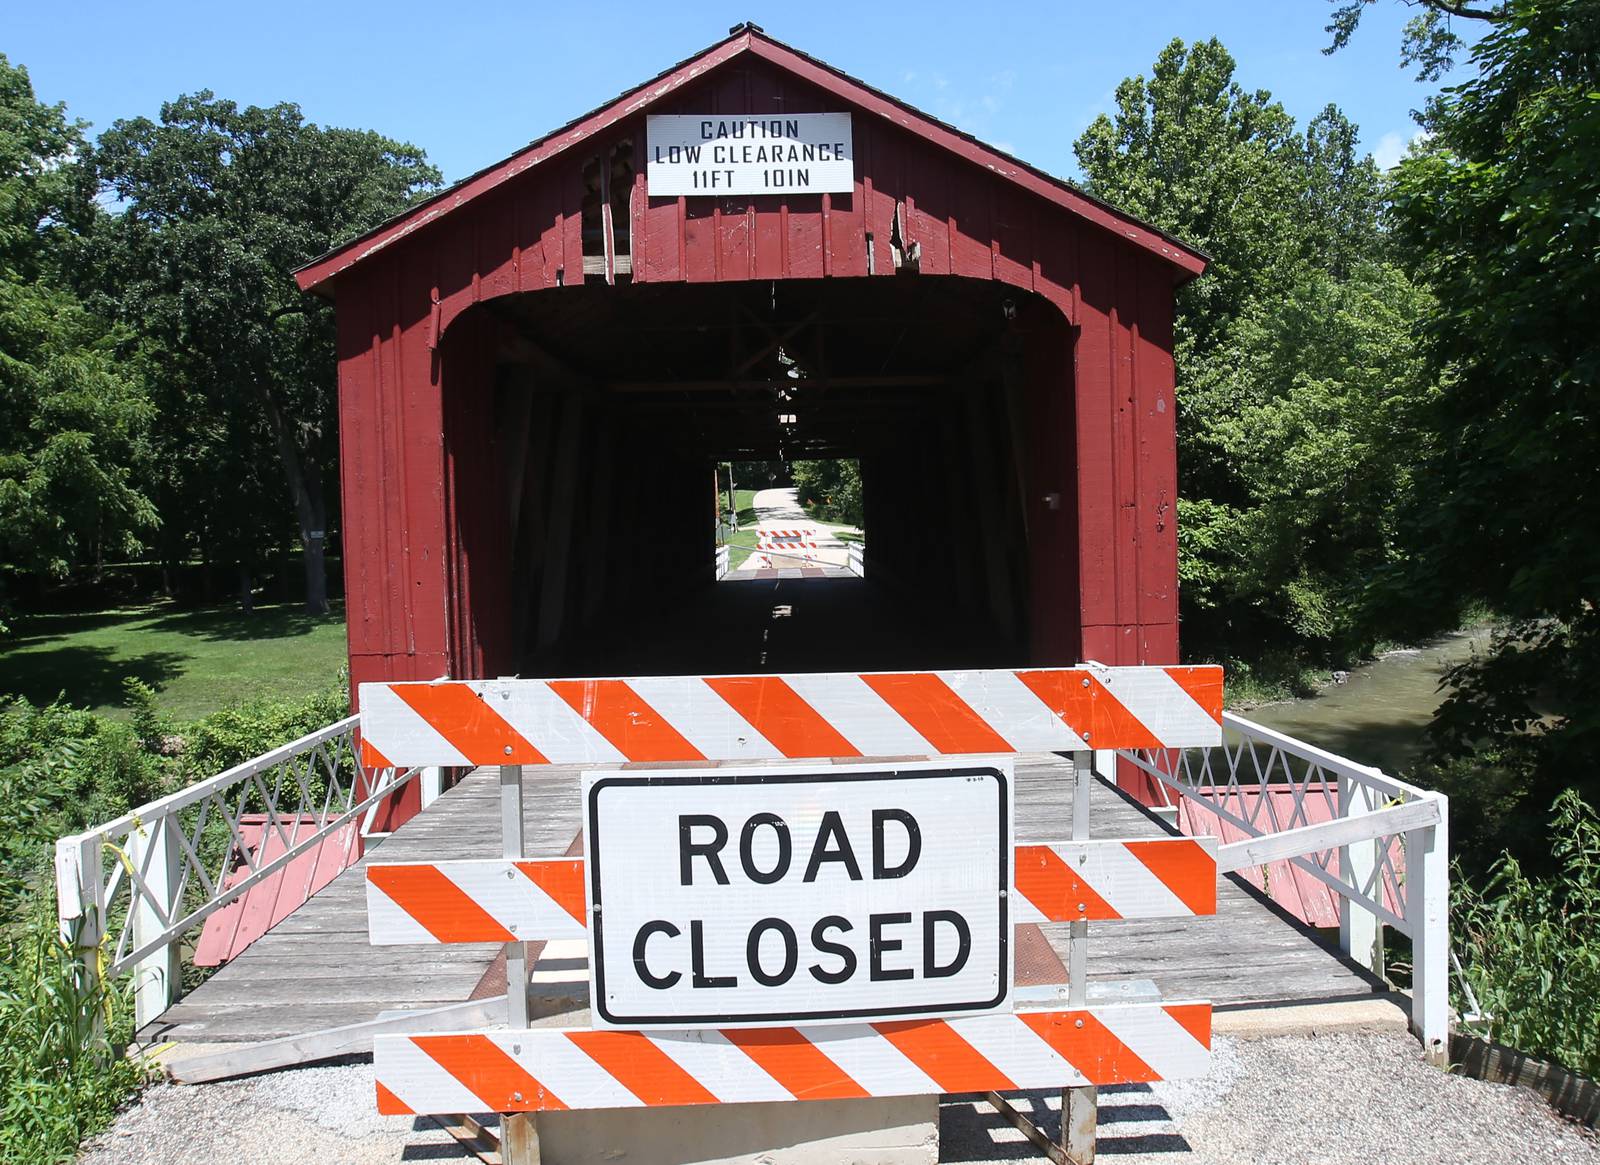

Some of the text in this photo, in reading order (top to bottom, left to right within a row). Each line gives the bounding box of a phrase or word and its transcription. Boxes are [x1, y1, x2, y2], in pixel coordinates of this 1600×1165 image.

[701, 120, 798, 139] CAUTION
[655, 143, 845, 164] LOW CLEARANCE
[693, 168, 809, 188] 11FT 10IN
[678, 808, 922, 886] ROAD
[632, 910, 971, 990] CLOSED
